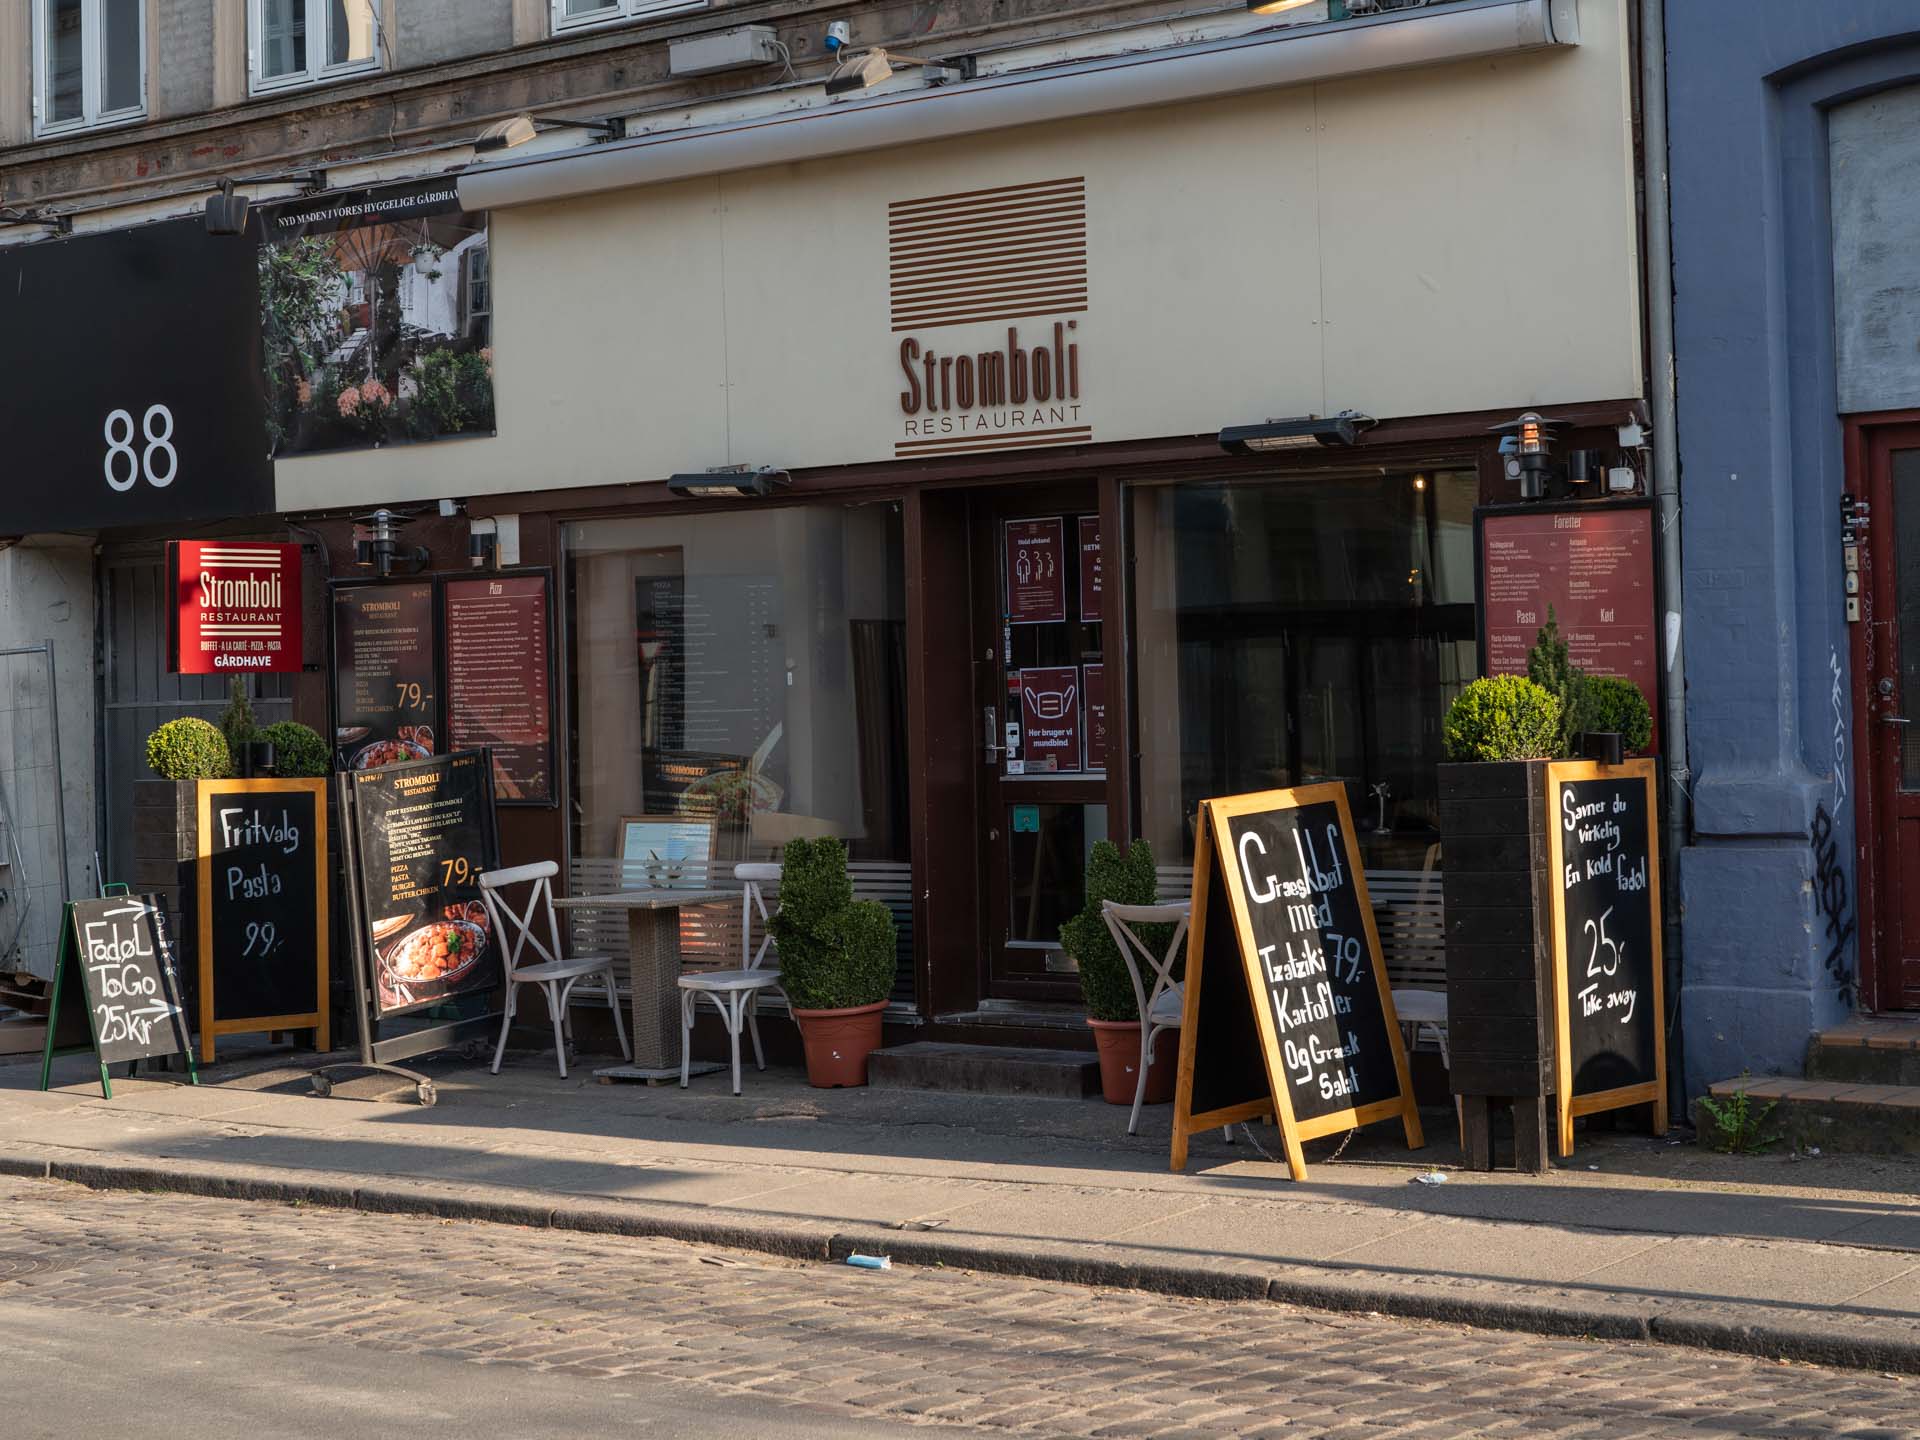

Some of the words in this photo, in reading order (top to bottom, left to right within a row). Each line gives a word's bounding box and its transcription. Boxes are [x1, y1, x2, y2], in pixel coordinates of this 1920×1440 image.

[278, 216, 296, 228] NYD
[296, 210, 327, 225] MADEN
[333, 204, 363, 218] VORES
[364, 195, 415, 213] HYGGELIGE
[900, 320, 1079, 415] Stromboli
[904, 405, 1081, 436] RESTAURANT
[104, 403, 178, 492] 88
[200, 571, 281, 608] Stromboli
[201, 613, 281, 622] RESTAURANT
[361, 601, 401, 612] STROMBOLI
[1516, 609, 1536, 624] Pasta
[1600, 607, 1615, 623] Kød
[214, 653, 272, 667] GÅRDHAVE
[250, 641, 264, 651] PIZZA
[267, 641, 282, 651] PASTA
[396, 683, 433, 712] 79,-
[1028, 729, 1040, 737] Her
[1041, 728, 1065, 738] bruger
[1065, 728, 1073, 736] vi
[1033, 738, 1068, 747] mundbind
[394, 772, 440, 790] STROMBOLI
[403, 785, 437, 797] RESTAURANT
[1563, 789, 1605, 831] Savner
[1612, 793, 1627, 813] du
[219, 808, 300, 854] Fritvalg
[227, 863, 281, 901] Pasta
[390, 864, 409, 873] PIZZA
[391, 874, 410, 883] PASTA
[440, 856, 483, 888] 79,-
[1565, 863, 1581, 889] En
[391, 881, 416, 892] BURGER
[1287, 893, 1333, 933] med
[1258, 939, 1327, 983] Tzatziki
[1272, 981, 1352, 1033] Kartofler
[1606, 987, 1637, 1024] away
[1318, 1066, 1360, 1100] Salat
